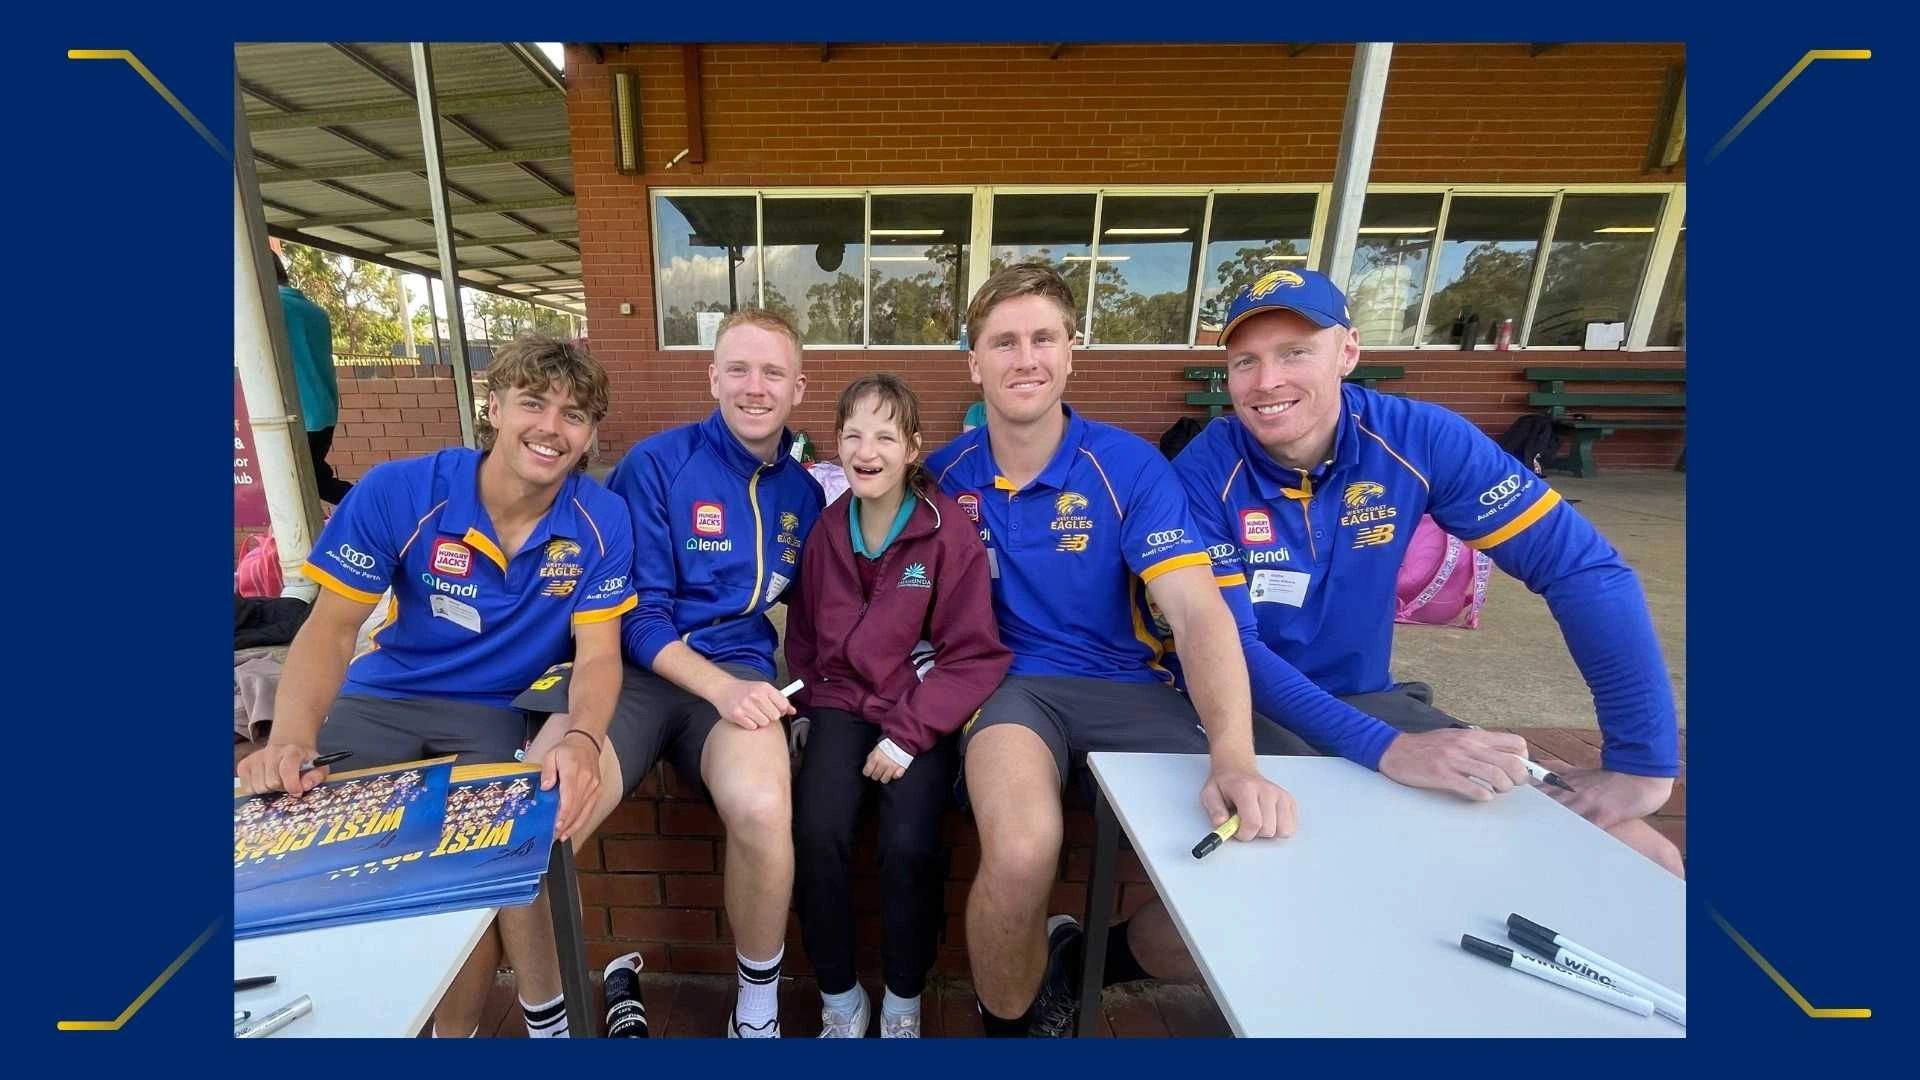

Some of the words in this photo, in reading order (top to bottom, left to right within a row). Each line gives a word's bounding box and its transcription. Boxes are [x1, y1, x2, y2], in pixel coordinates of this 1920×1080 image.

[235, 437, 245, 449] &
[1366, 504, 1386, 512] COAST
[1477, 508, 1497, 521] Audi
[1498, 492, 1521, 510] Centre
[1341, 507, 1397, 526] EAGLES
[1051, 520, 1093, 530] EAGLES
[699, 538, 732, 551] lendi
[439, 550, 468, 560] HUNGRY
[1250, 547, 1290, 564] lendi
[540, 567, 585, 578] EAGLES
[435, 577, 478, 599] lendi
[317, 805, 405, 847] WEST
[428, 819, 515, 858] WEST
